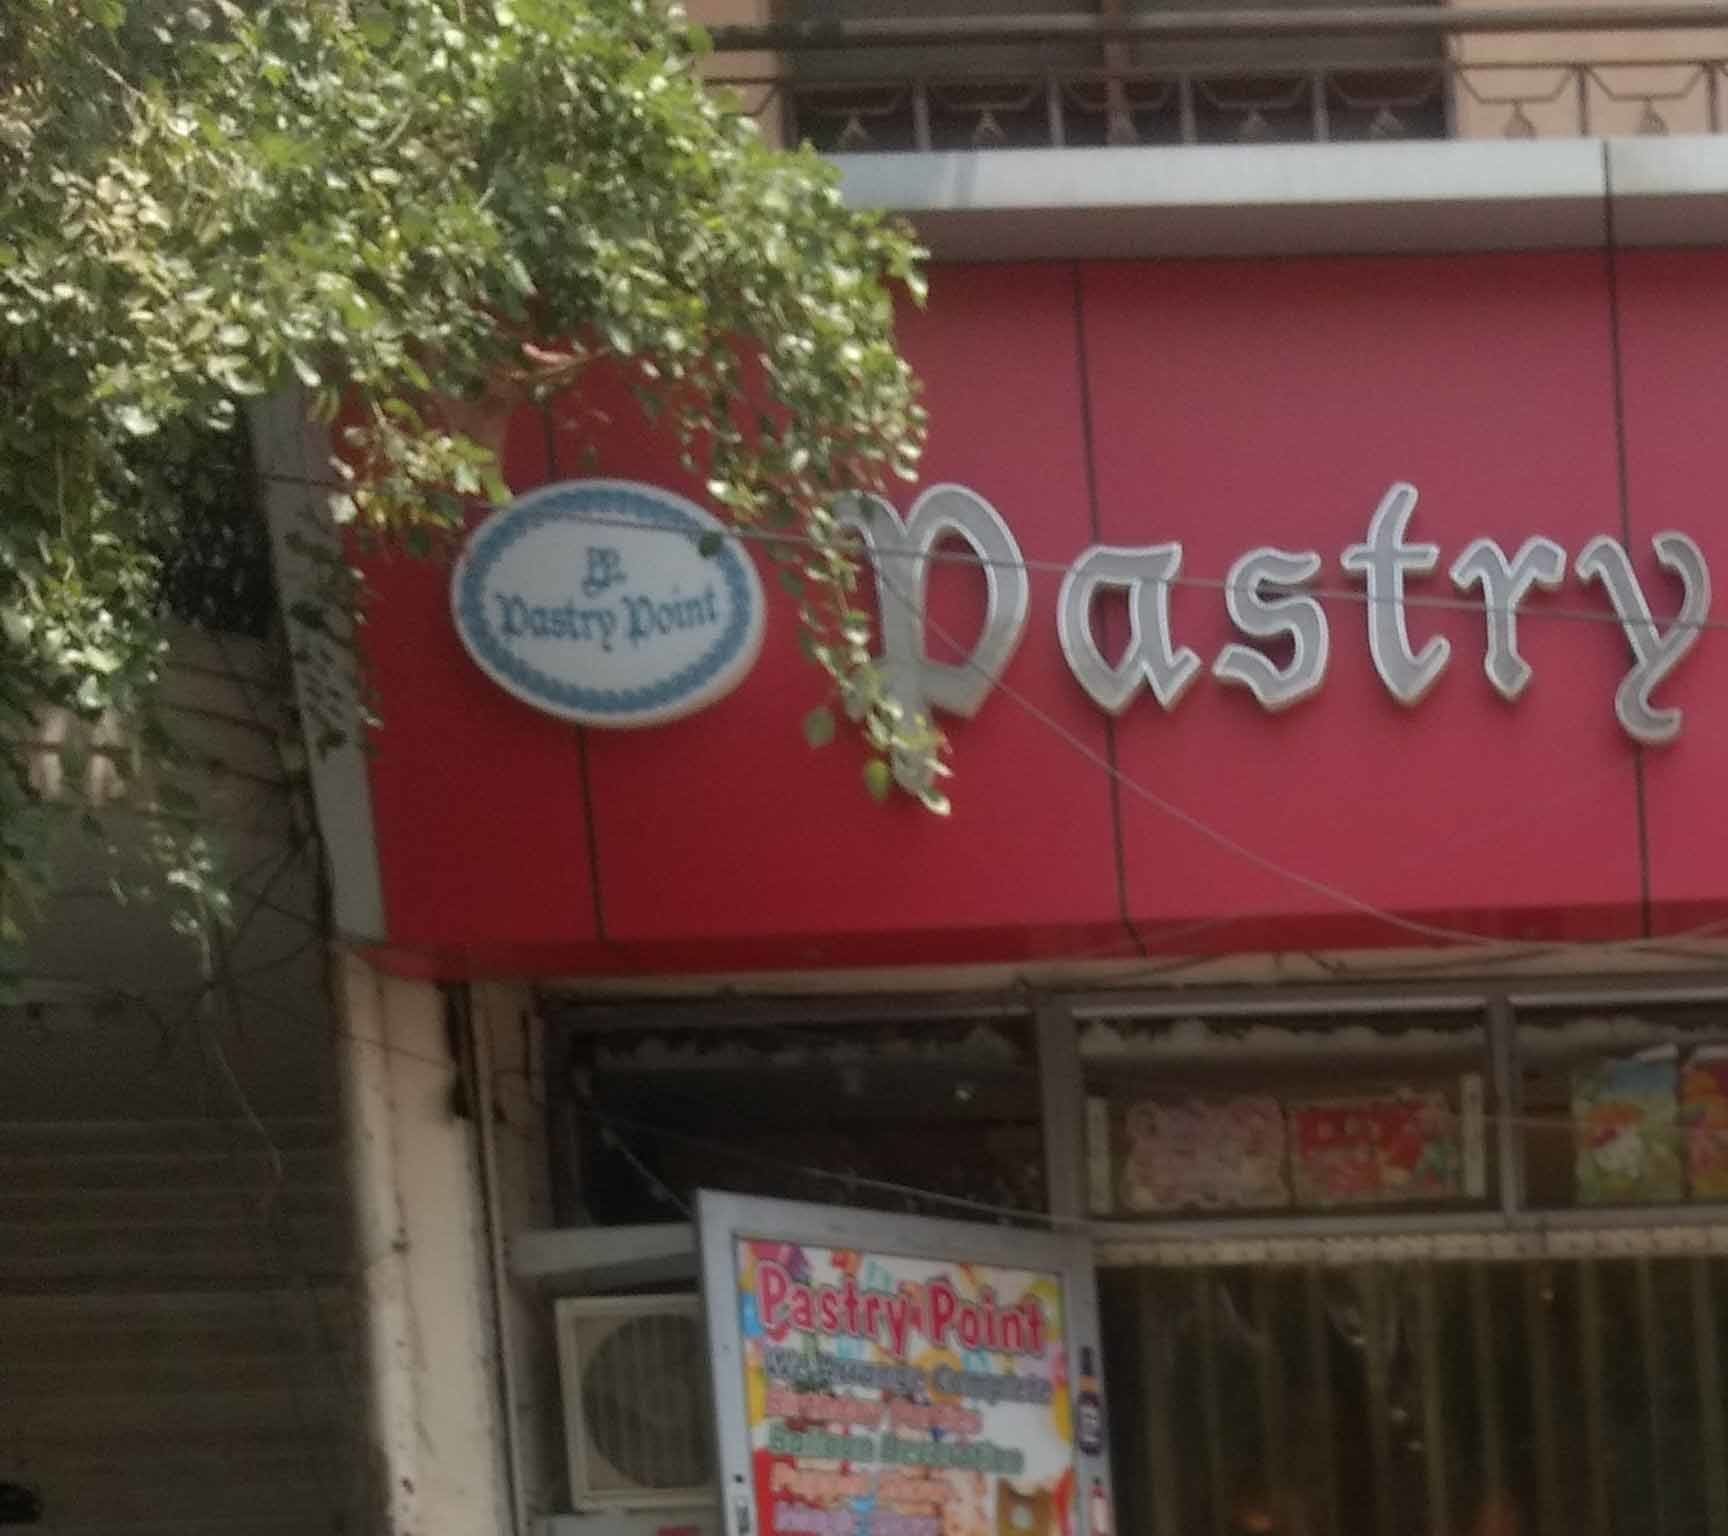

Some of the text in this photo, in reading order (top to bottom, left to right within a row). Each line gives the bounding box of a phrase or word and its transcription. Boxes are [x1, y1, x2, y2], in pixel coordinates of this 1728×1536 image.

[494, 584, 720, 653] Pastry Point
[836, 480, 1712, 792] Pastry
[757, 1260, 1046, 1358] Pastry Point
